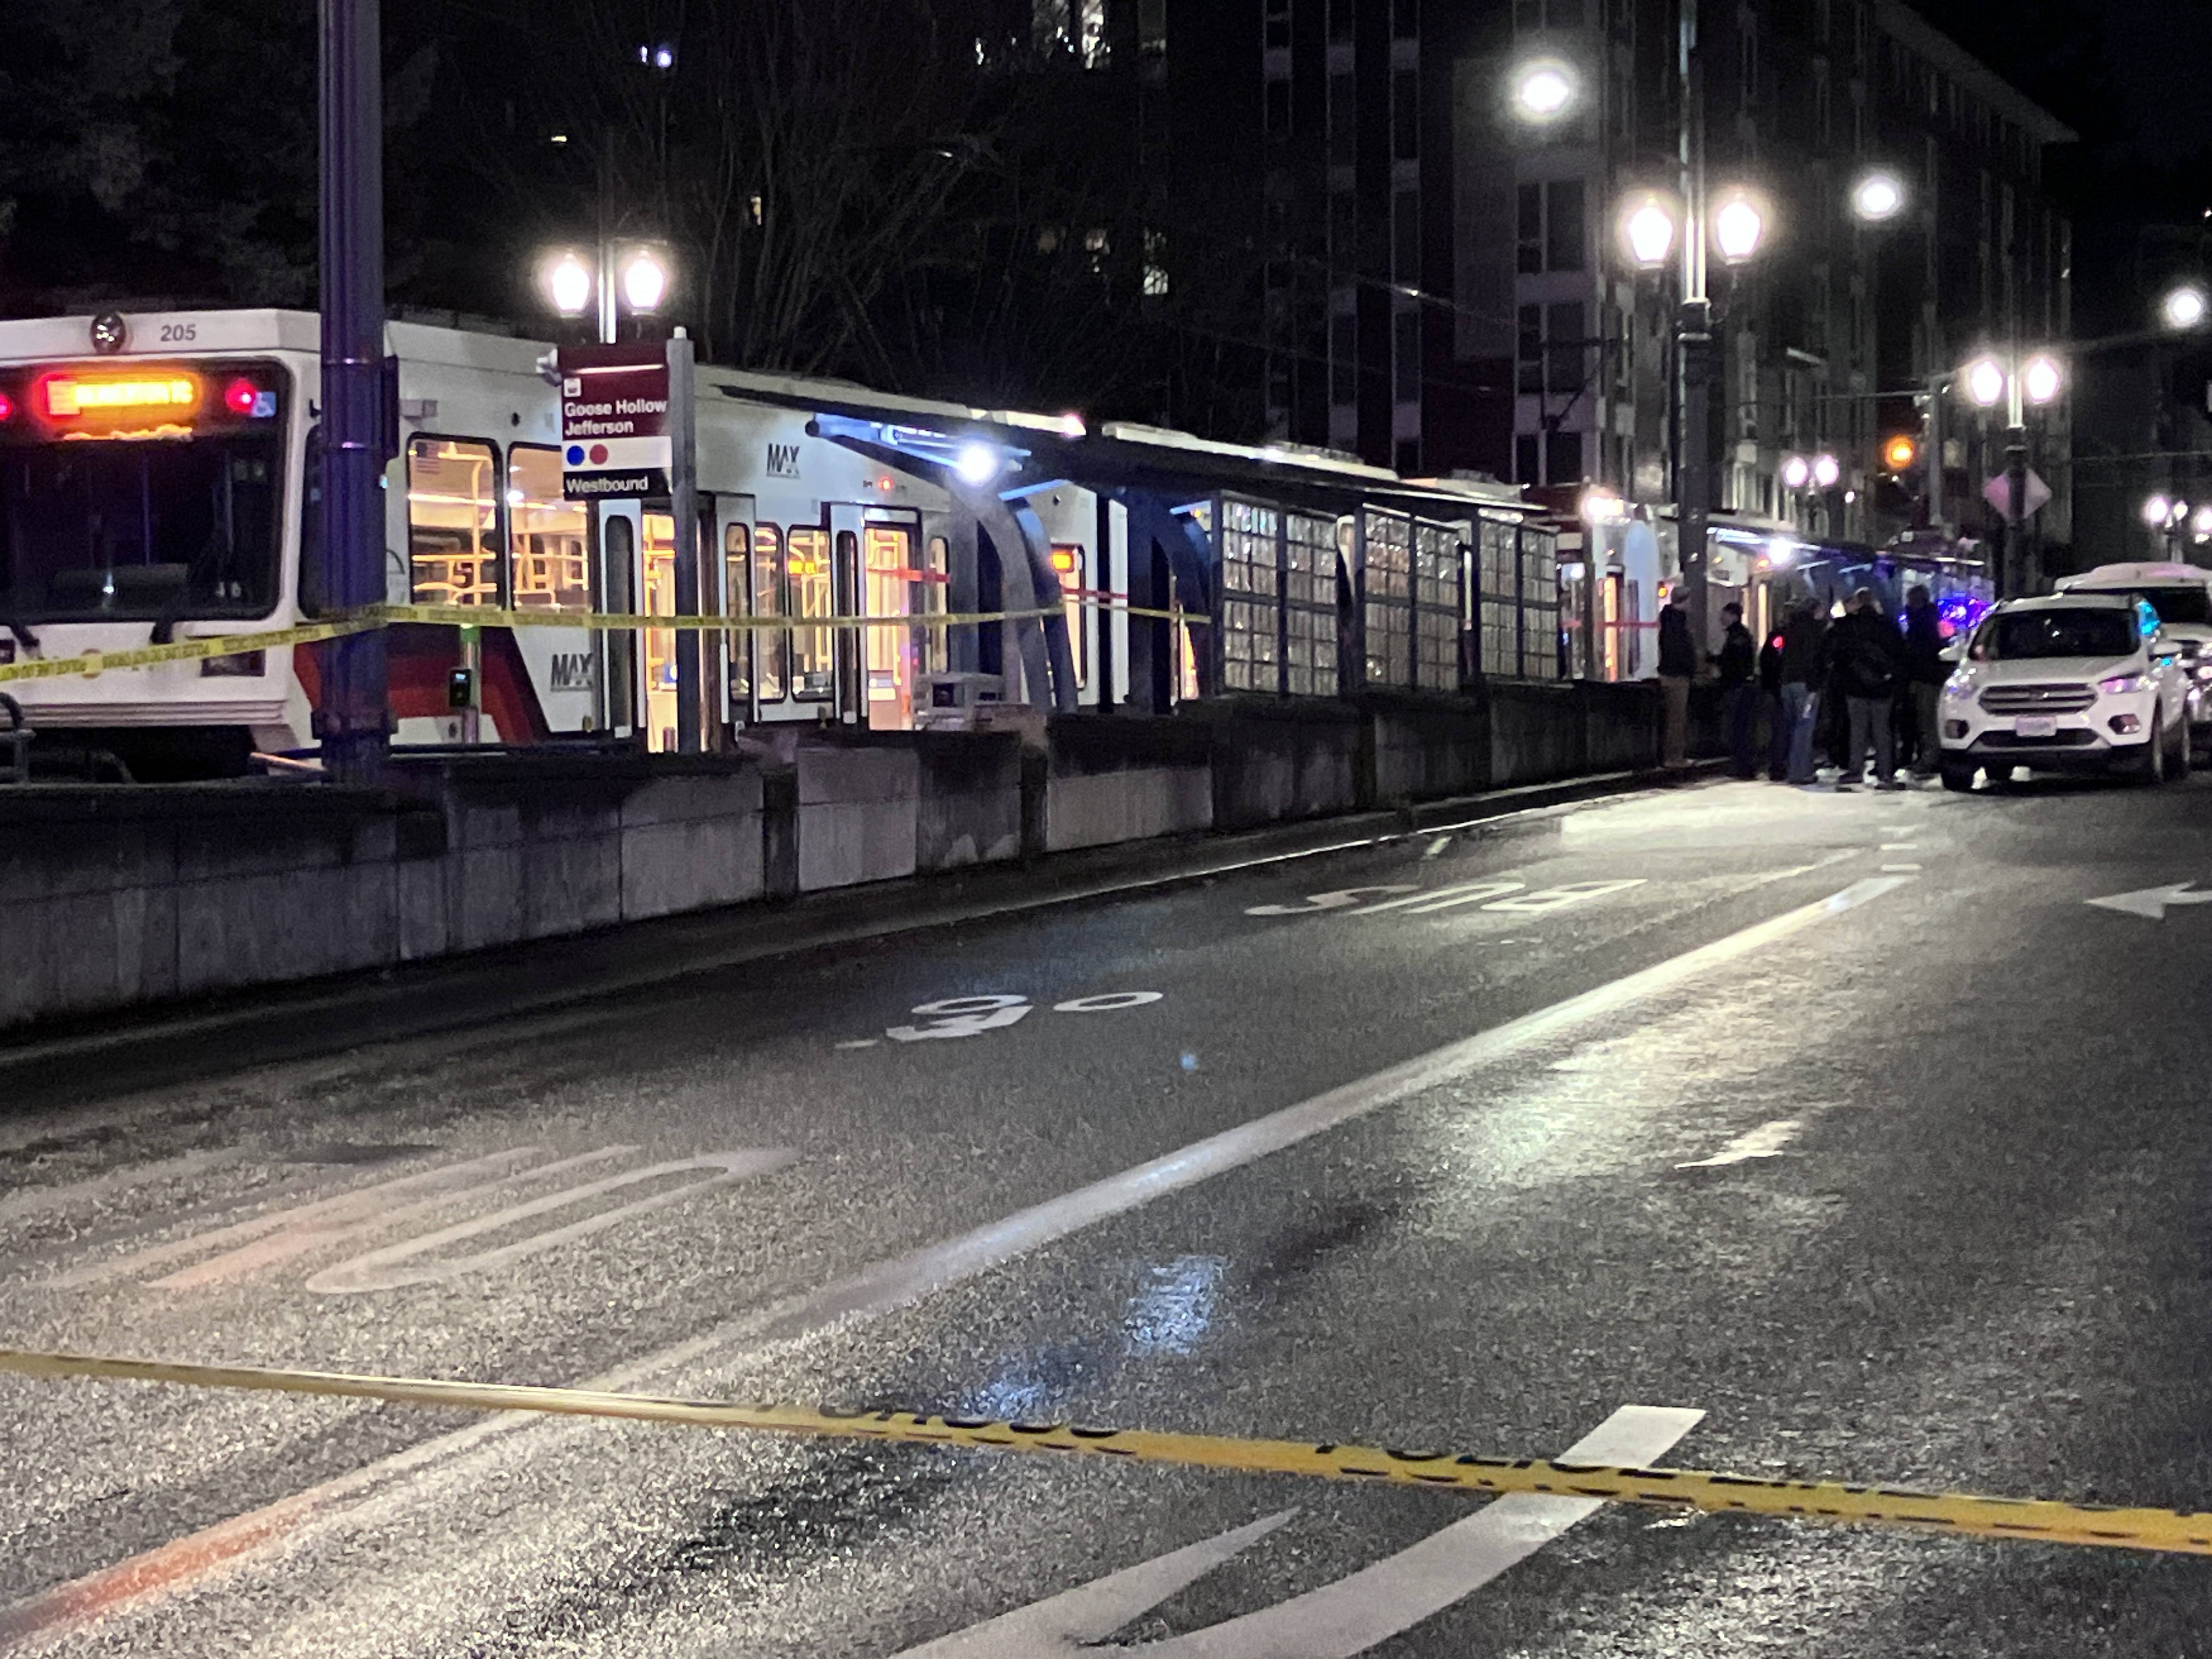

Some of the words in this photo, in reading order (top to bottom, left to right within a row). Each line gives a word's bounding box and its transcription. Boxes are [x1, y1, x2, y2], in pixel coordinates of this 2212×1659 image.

[161, 324, 196, 341] 205
[565, 402, 612, 417] Goose
[616, 399, 667, 414] Hollow
[565, 420, 634, 436] Jefferson
[767, 443, 800, 475] MAX
[566, 473, 648, 493] Westbound
[551, 653, 592, 687] MAX
